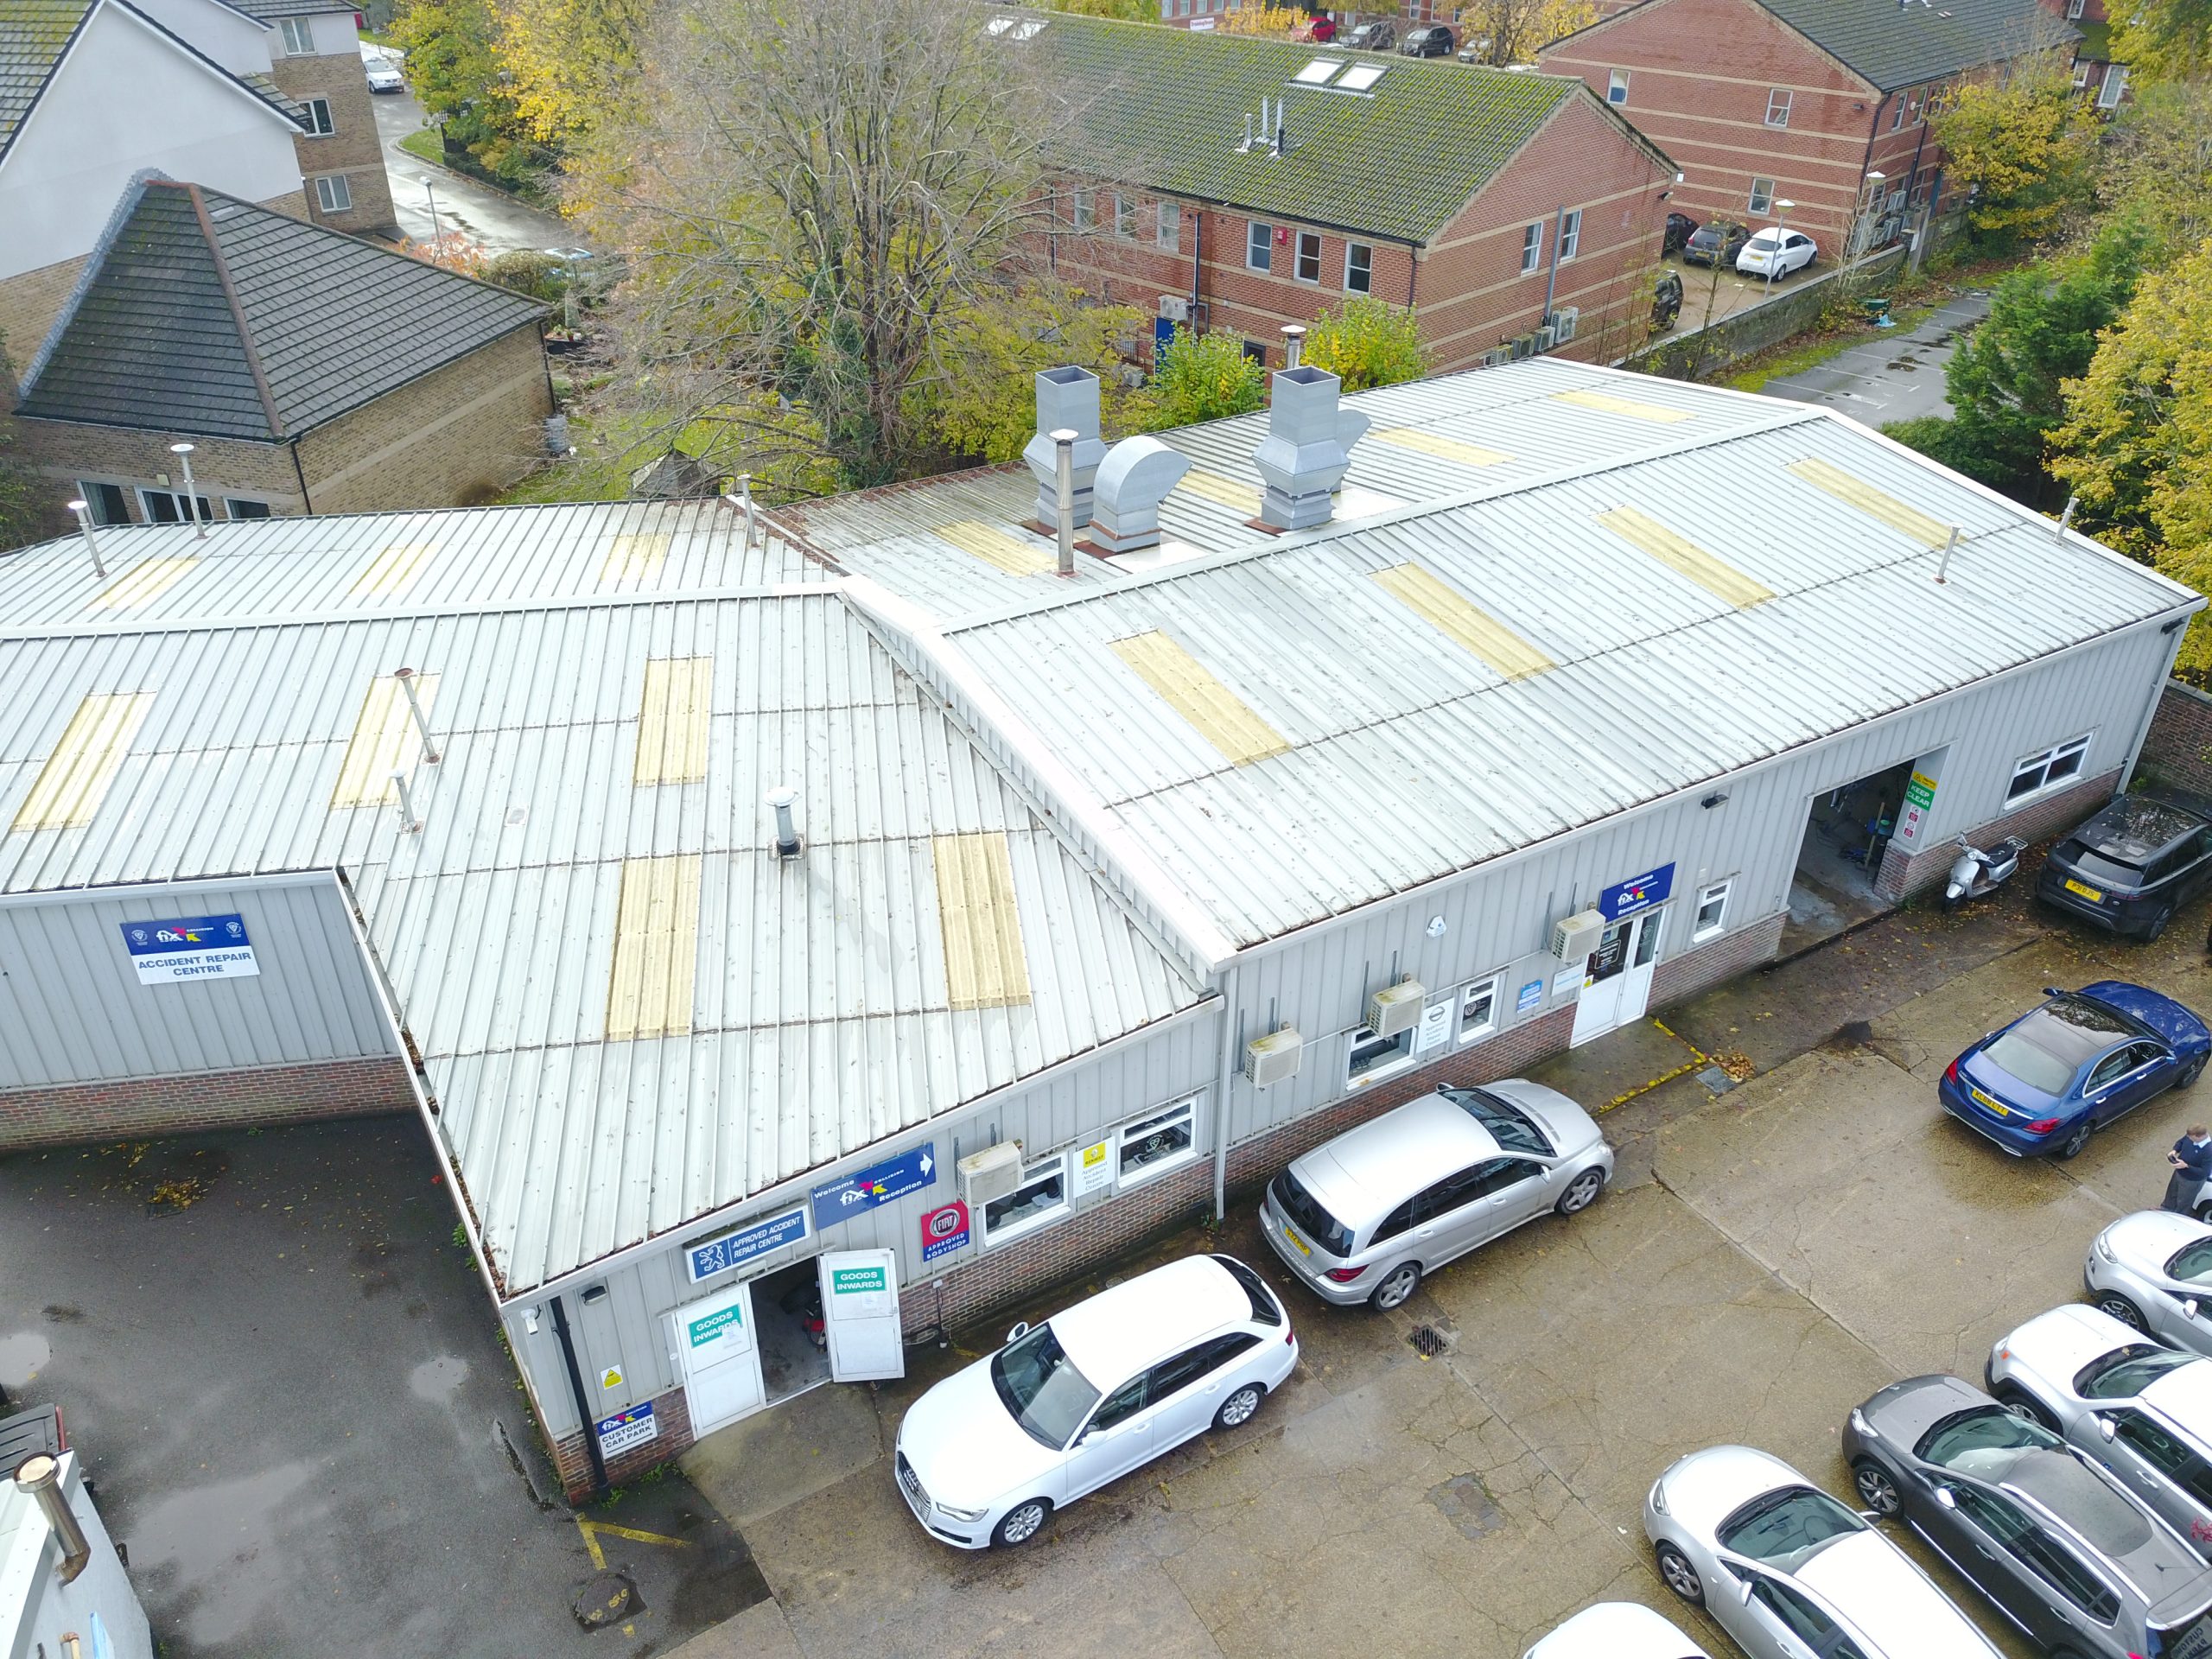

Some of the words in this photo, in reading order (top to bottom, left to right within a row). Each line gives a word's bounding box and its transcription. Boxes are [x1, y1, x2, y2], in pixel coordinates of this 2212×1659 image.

[1907, 791, 1929, 807] CLEAR
[1911, 785, 1929, 798] KEEP
[1624, 874, 1654, 889] Welcome
[139, 956, 200, 969] ACCIDENT
[206, 952, 251, 963] REPAIR
[173, 964, 225, 976] CENTRE
[814, 1179, 855, 1198] Welcome
[840, 1189, 868, 1205] fix
[879, 1180, 922, 1202] Reception
[733, 1230, 767, 1248] APPROVED
[769, 1216, 801, 1234] ACCIDENT
[937, 1215, 954, 1231] FIAT
[734, 1245, 757, 1258] REPAIR
[758, 1233, 783, 1249] CENTRE
[926, 1240, 966, 1259] BODYSHOP
[928, 1233, 964, 1251] APPROVED
[840, 1271, 878, 1281] GOODS
[837, 1281, 882, 1290] INWARDS
[696, 1312, 734, 1331] GOODS
[694, 1319, 739, 1343] INWARDS
[602, 1417, 652, 1442] CUSTOMER
[606, 1438, 625, 1448] CAR
[627, 1426, 652, 1439] PARK
